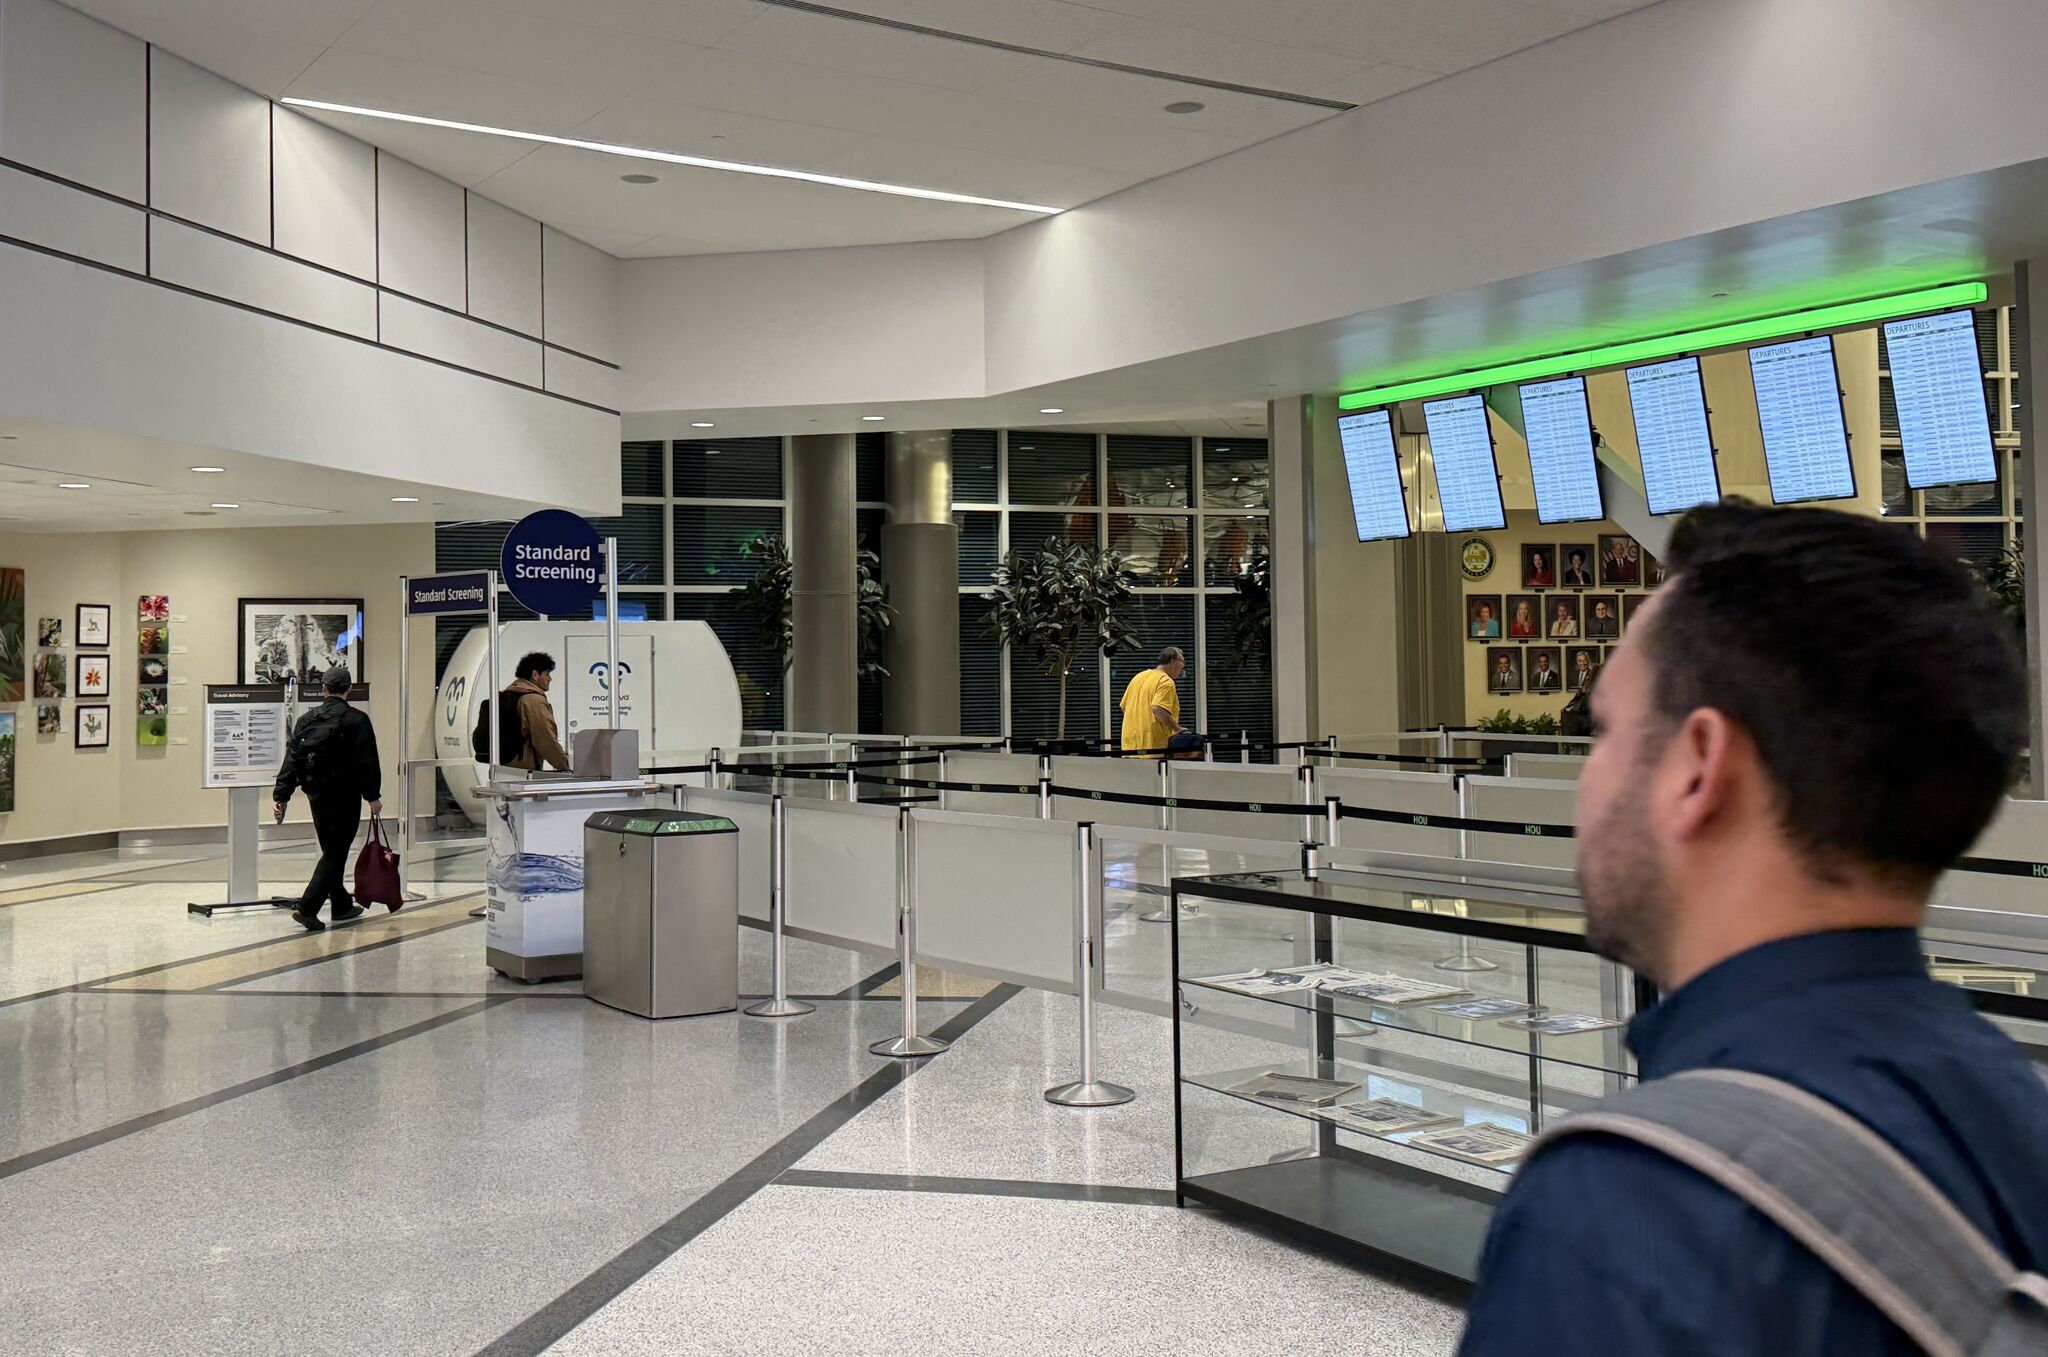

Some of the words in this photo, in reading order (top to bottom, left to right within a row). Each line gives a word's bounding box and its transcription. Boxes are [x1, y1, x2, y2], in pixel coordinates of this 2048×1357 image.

[1886, 321, 1930, 335] DEPARTURES
[1751, 346, 1792, 360] DEPARTURES
[1629, 367, 1664, 379] DEPARTURES
[515, 545, 591, 561] Standard
[515, 564, 596, 584] Screening
[414, 588, 446, 603] Standard
[447, 586, 484, 602] Screening
[1091, 791, 1102, 799] HOU
[1166, 799, 1178, 807] HOU
[1249, 803, 1262, 812] HOU
[1413, 815, 1428, 826] HOU
[1525, 825, 1541, 835] HOU
[2033, 863, 2048, 877] HO
